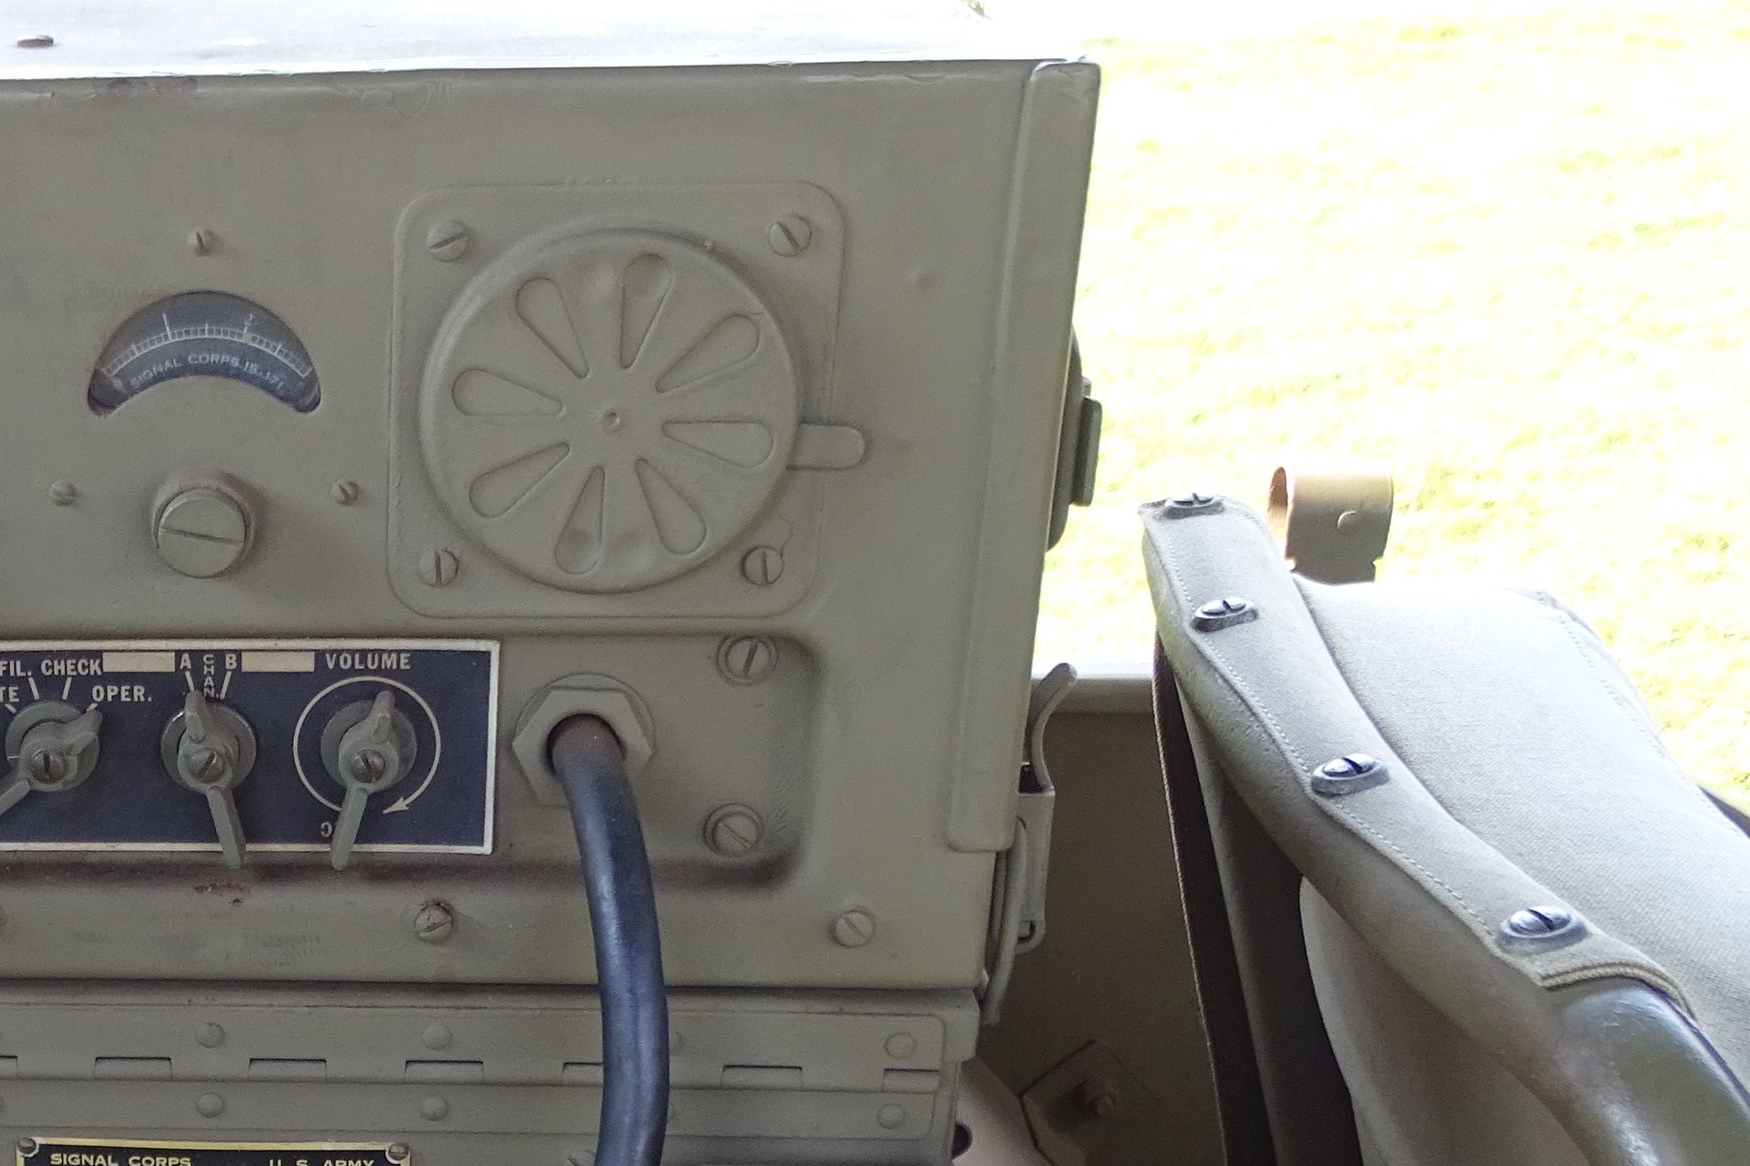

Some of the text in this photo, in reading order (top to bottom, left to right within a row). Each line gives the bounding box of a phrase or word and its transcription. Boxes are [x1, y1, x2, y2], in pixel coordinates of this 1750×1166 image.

[130, 357, 182, 388] SIGNAL
[188, 354, 240, 368] CORPS
[41, 659, 103, 677] CHECK
[180, 653, 192, 670] A
[225, 653, 238, 670] B
[325, 653, 411, 670] VOLUME
[92, 685, 154, 703] OPER.
[50, 1154, 119, 1166] SIGNAL
